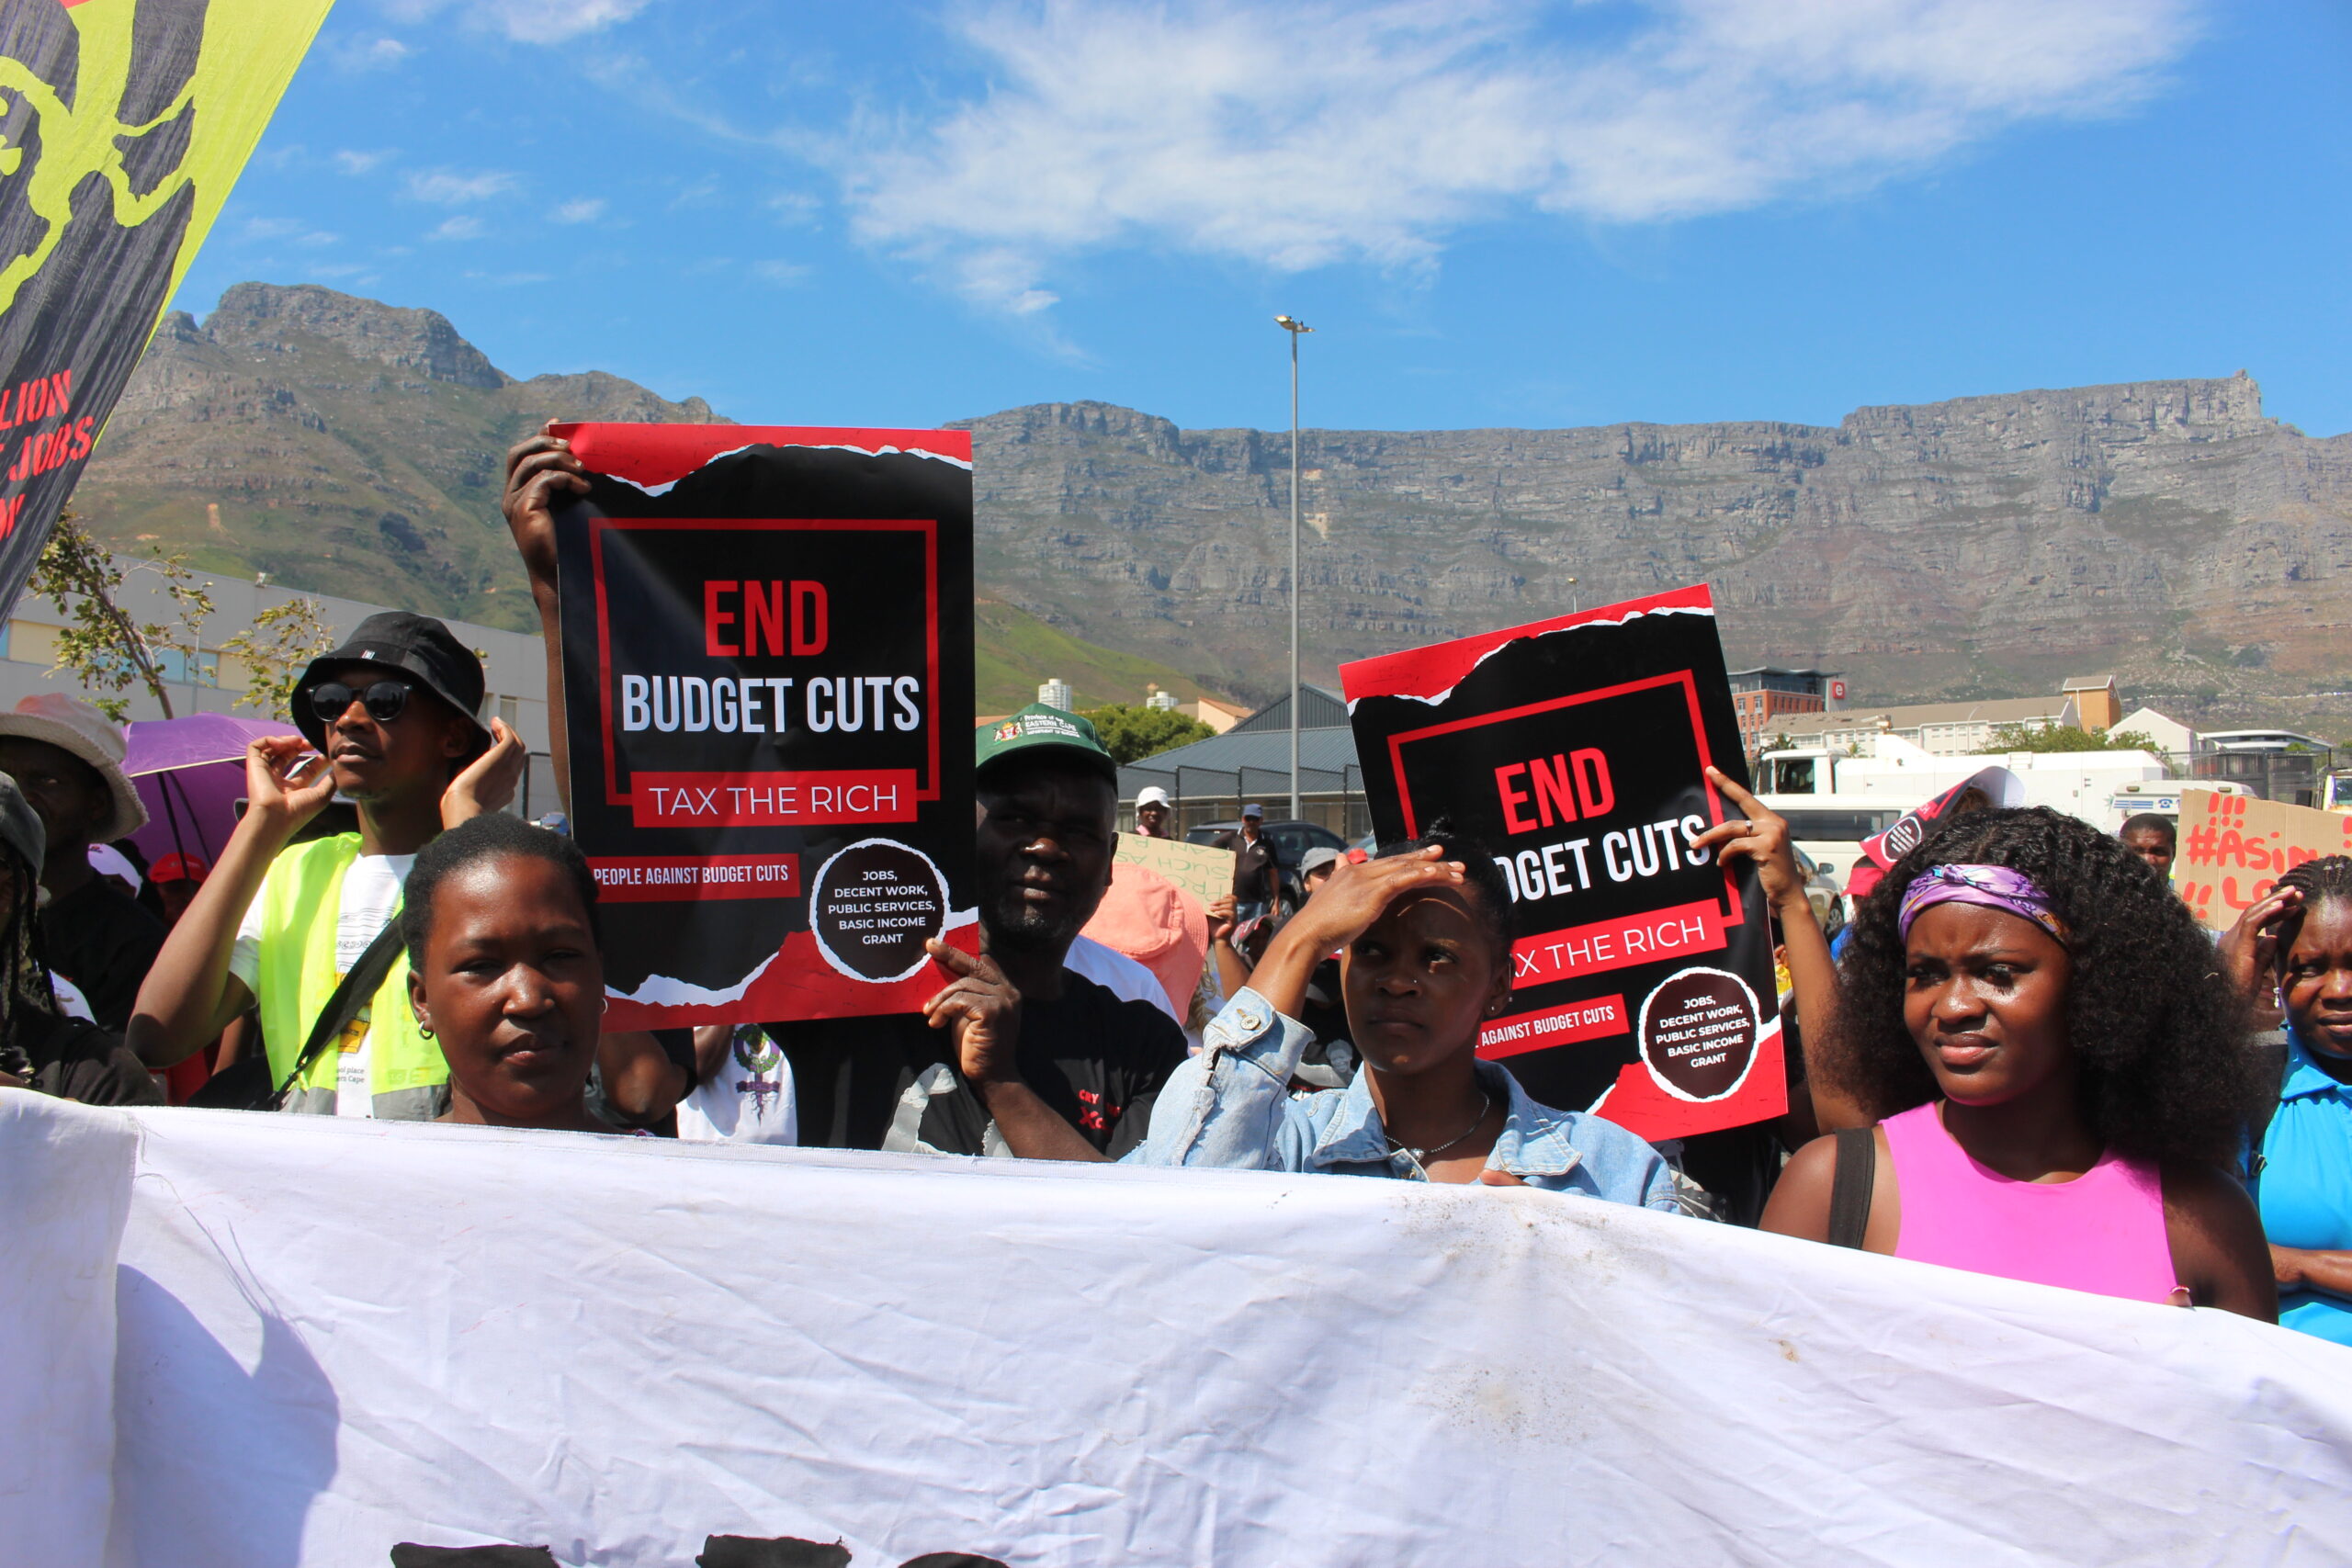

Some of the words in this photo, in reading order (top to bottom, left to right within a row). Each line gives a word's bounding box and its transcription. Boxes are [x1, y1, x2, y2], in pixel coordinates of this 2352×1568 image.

[8, 416, 95, 481] JOBS
[704, 580, 829, 657] END
[621, 674, 793, 733] BUDGET
[806, 676, 920, 732] CUTS
[649, 786, 718, 815] TAX
[727, 785, 798, 815] THE
[810, 784, 898, 813] RICH
[1494, 747, 1616, 835] END
[1602, 814, 1710, 882] CUTS
[594, 866, 642, 886] PEOPLE
[645, 866, 698, 885] AGAINST
[702, 864, 753, 884] BUDGET
[756, 864, 788, 882] CUTS
[863, 870, 898, 882] JOBS,
[1158, 857, 1229, 879] SUCH
[834, 886, 883, 898] DECENT
[885, 884, 928, 897] WORK,
[828, 902, 872, 915] PUBLIC
[875, 899, 936, 913] SERVICES,
[839, 919, 875, 930] BASIC
[876, 917, 926, 929] INCOME
[862, 933, 903, 945] GRANT
[1544, 934, 1616, 969] THE
[1622, 916, 1706, 956] RICH
[1683, 995, 1716, 1010] JOBS,
[1481, 1022, 1530, 1046] AGAINST
[1533, 1012, 1579, 1034] BUDGET
[1583, 1006, 1614, 1024] CUTS
[1659, 1011, 1704, 1028] DECENT
[1706, 1004, 1743, 1020] WORK,
[1656, 1028, 1697, 1043] PUBLIC
[1699, 1018, 1749, 1036] SERVICES,
[1668, 1043, 1701, 1056] BASIC
[1702, 1033, 1744, 1050] INCOME
[1690, 1053, 1726, 1067] GRANT
